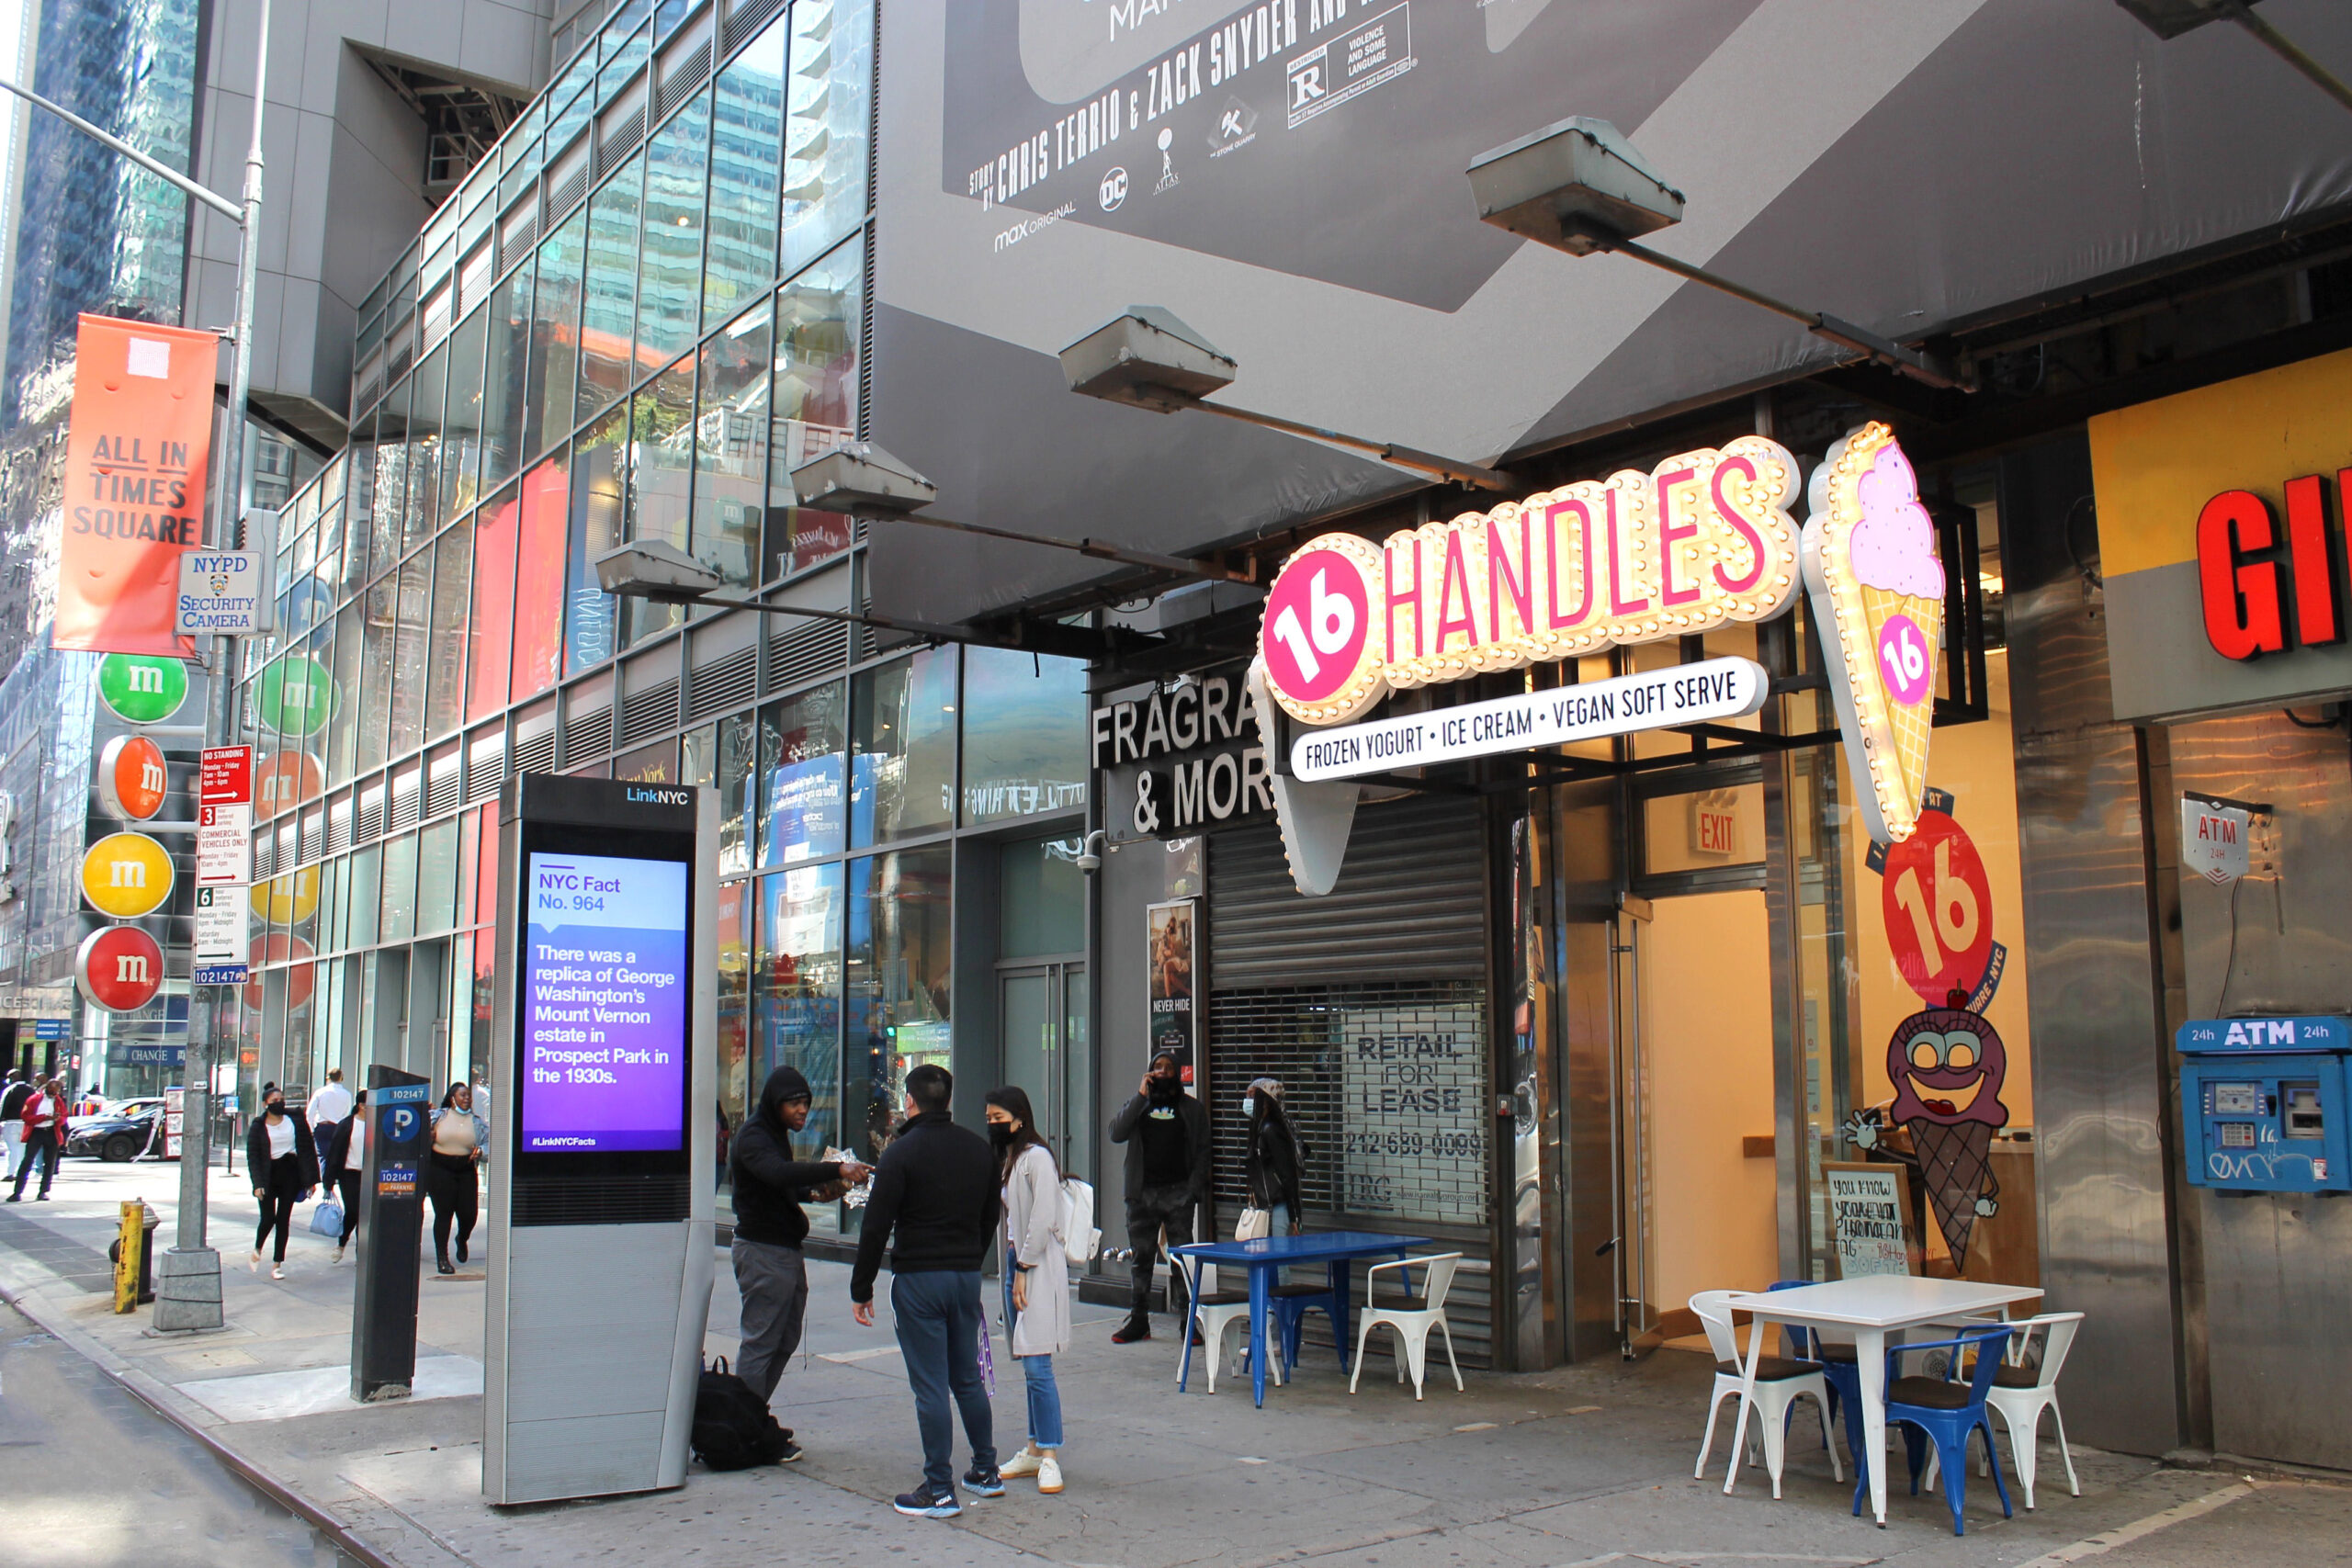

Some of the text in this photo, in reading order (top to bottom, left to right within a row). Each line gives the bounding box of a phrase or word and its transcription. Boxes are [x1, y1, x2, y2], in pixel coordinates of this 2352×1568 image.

[1349, 25, 1385, 51] VIOLENCE
[1289, 48, 1325, 71] RESTRICTED
[1348, 37, 1386, 65] AND SOME
[1348, 49, 1386, 77] LANGUAGE
[1291, 66, 1325, 109] R
[998, 130, 1048, 203] CHRIS
[1056, 88, 1120, 171] TERRIO
[1130, 90, 1138, 130] &
[1148, 42, 1201, 121] ZACK
[1210, 0, 1297, 86] SNYDER
[1216, 144, 1234, 157] STONE
[1235, 132, 1256, 148] QUARRY
[969, 161, 994, 196] STORY
[1102, 173, 1125, 207] DC
[983, 186, 993, 212] BY
[995, 201, 1076, 253] max ORIGINAL
[93, 434, 187, 467] ALL IN
[89, 472, 187, 509] TIMES
[73, 506, 198, 547] SQUARE
[193, 557, 248, 573] NYPD
[1272, 456, 1765, 683] 16 HANDLES
[179, 595, 255, 612] SECURITY
[182, 612, 250, 627] CAMERA
[1883, 626, 1924, 693] 16
[129, 665, 164, 694] m
[1306, 671, 1736, 770] FROZEN YOGURT ICE CREAM VEGAN SOFT SERVE
[214, 750, 243, 760] STANDING
[141, 761, 163, 793] m
[627, 787, 688, 806] LinkNYC
[1134, 770, 1159, 834] &
[204, 808, 212, 824] 3
[202, 829, 241, 839] COMMERCIAL
[1702, 813, 1733, 852] EXIT
[2199, 816, 2236, 844] ATM
[202, 838, 247, 848] VEHICLES ONLY
[2211, 848, 2225, 860] 24H
[110, 861, 145, 887] m
[539, 874, 620, 893] NYC Fact
[201, 889, 209, 906] 6
[538, 894, 605, 911] No. 964
[1894, 838, 1979, 979] 16
[536, 944, 636, 964] There was a
[1989, 948, 2003, 980] NYC
[116, 954, 148, 983] m
[197, 971, 235, 983] 102147
[536, 965, 675, 987] replica of George
[536, 986, 646, 1006] Washington's
[1153, 998, 1191, 1012] NEVER HIDE
[535, 1006, 650, 1024] Mount Vernon
[534, 1027, 605, 1043] estate in
[2192, 1021, 2329, 1045] 24h ATM 24h
[131, 1050, 167, 1061] CHANGE
[534, 1047, 669, 1066] Prospect Park in
[1358, 1034, 1463, 1060] RETAIL
[533, 1068, 617, 1084] the 1930s.
[1385, 1065, 1433, 1084] FOR
[393, 1090, 424, 1099] 102147
[1363, 1089, 1461, 1112] LEASE
[395, 1110, 413, 1137] P
[533, 1137, 596, 1146] #LinkNYCFacts
[382, 1173, 413, 1182] 102147
